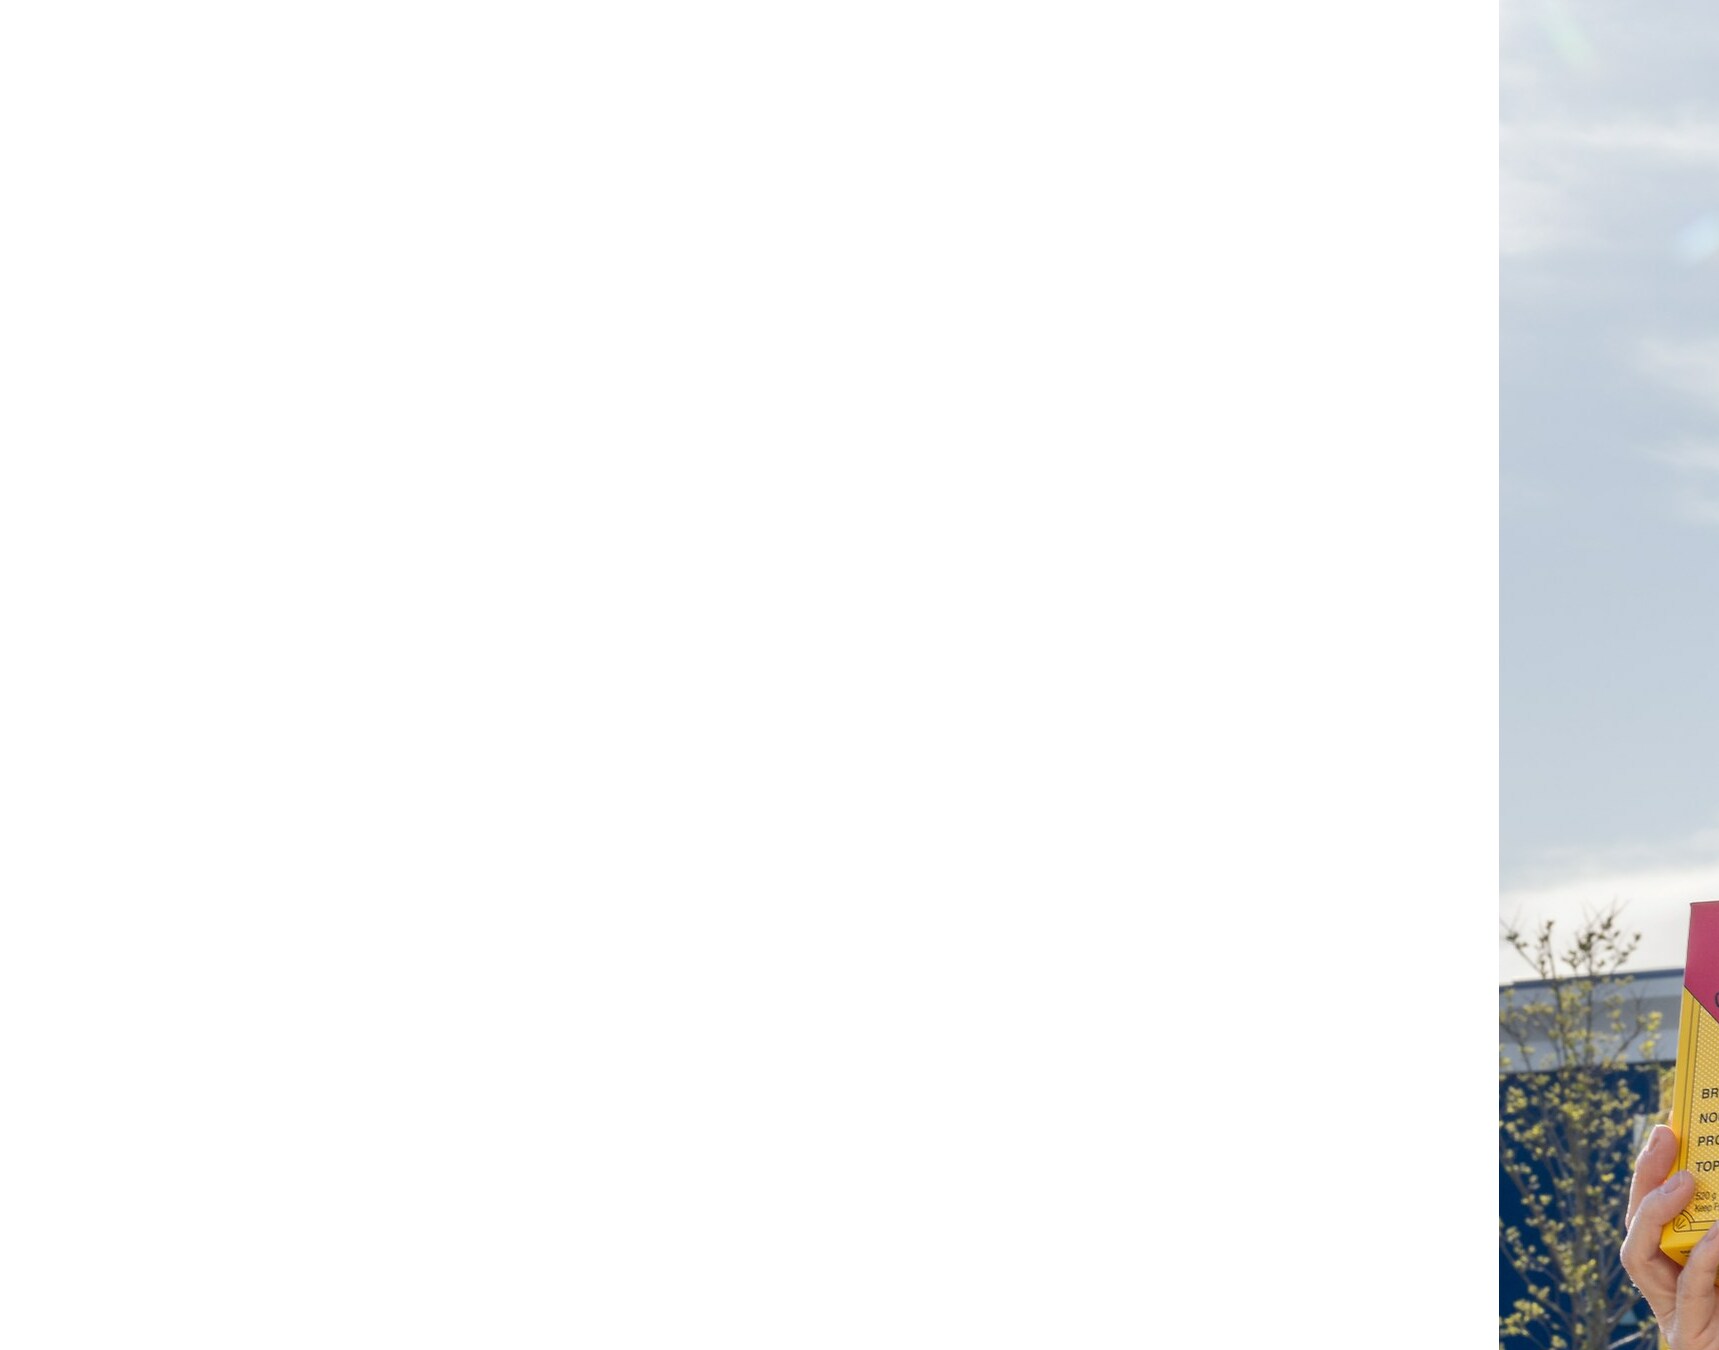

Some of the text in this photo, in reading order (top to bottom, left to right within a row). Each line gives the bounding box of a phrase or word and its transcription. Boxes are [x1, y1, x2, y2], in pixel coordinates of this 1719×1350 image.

[1695, 1191, 1716, 1202] 520 g
[1694, 1203, 1713, 1212] Keep
